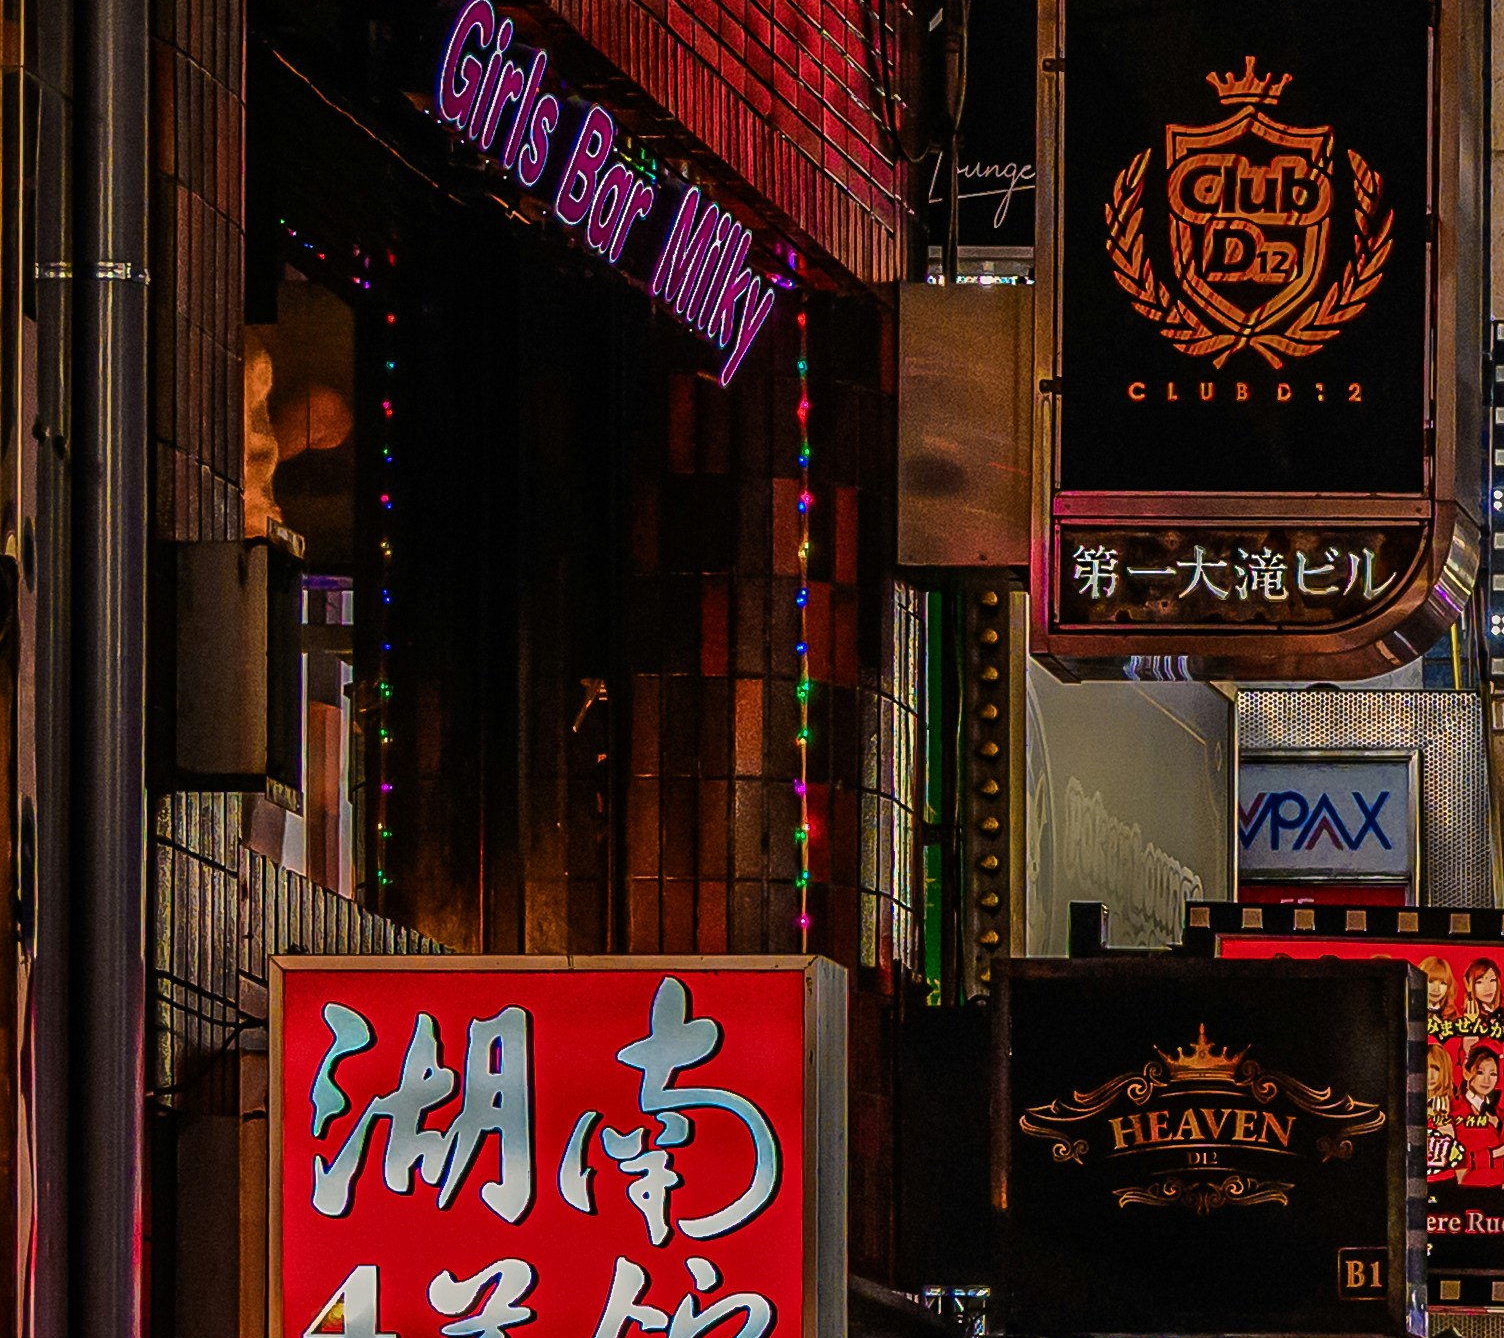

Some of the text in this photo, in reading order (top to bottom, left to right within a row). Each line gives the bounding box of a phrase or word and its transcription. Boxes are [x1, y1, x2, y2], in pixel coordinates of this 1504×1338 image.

[1181, 161, 1323, 218] Club
[553, 101, 660, 264] Bar
[652, 184, 775, 388] Milky
[1072, 544, 1398, 602] 第一大滝ビル
[310, 976, 783, 1247] 湖南
[1107, 1108, 1297, 1153] HEAVEN
[1344, 1260, 1384, 1290] B1
